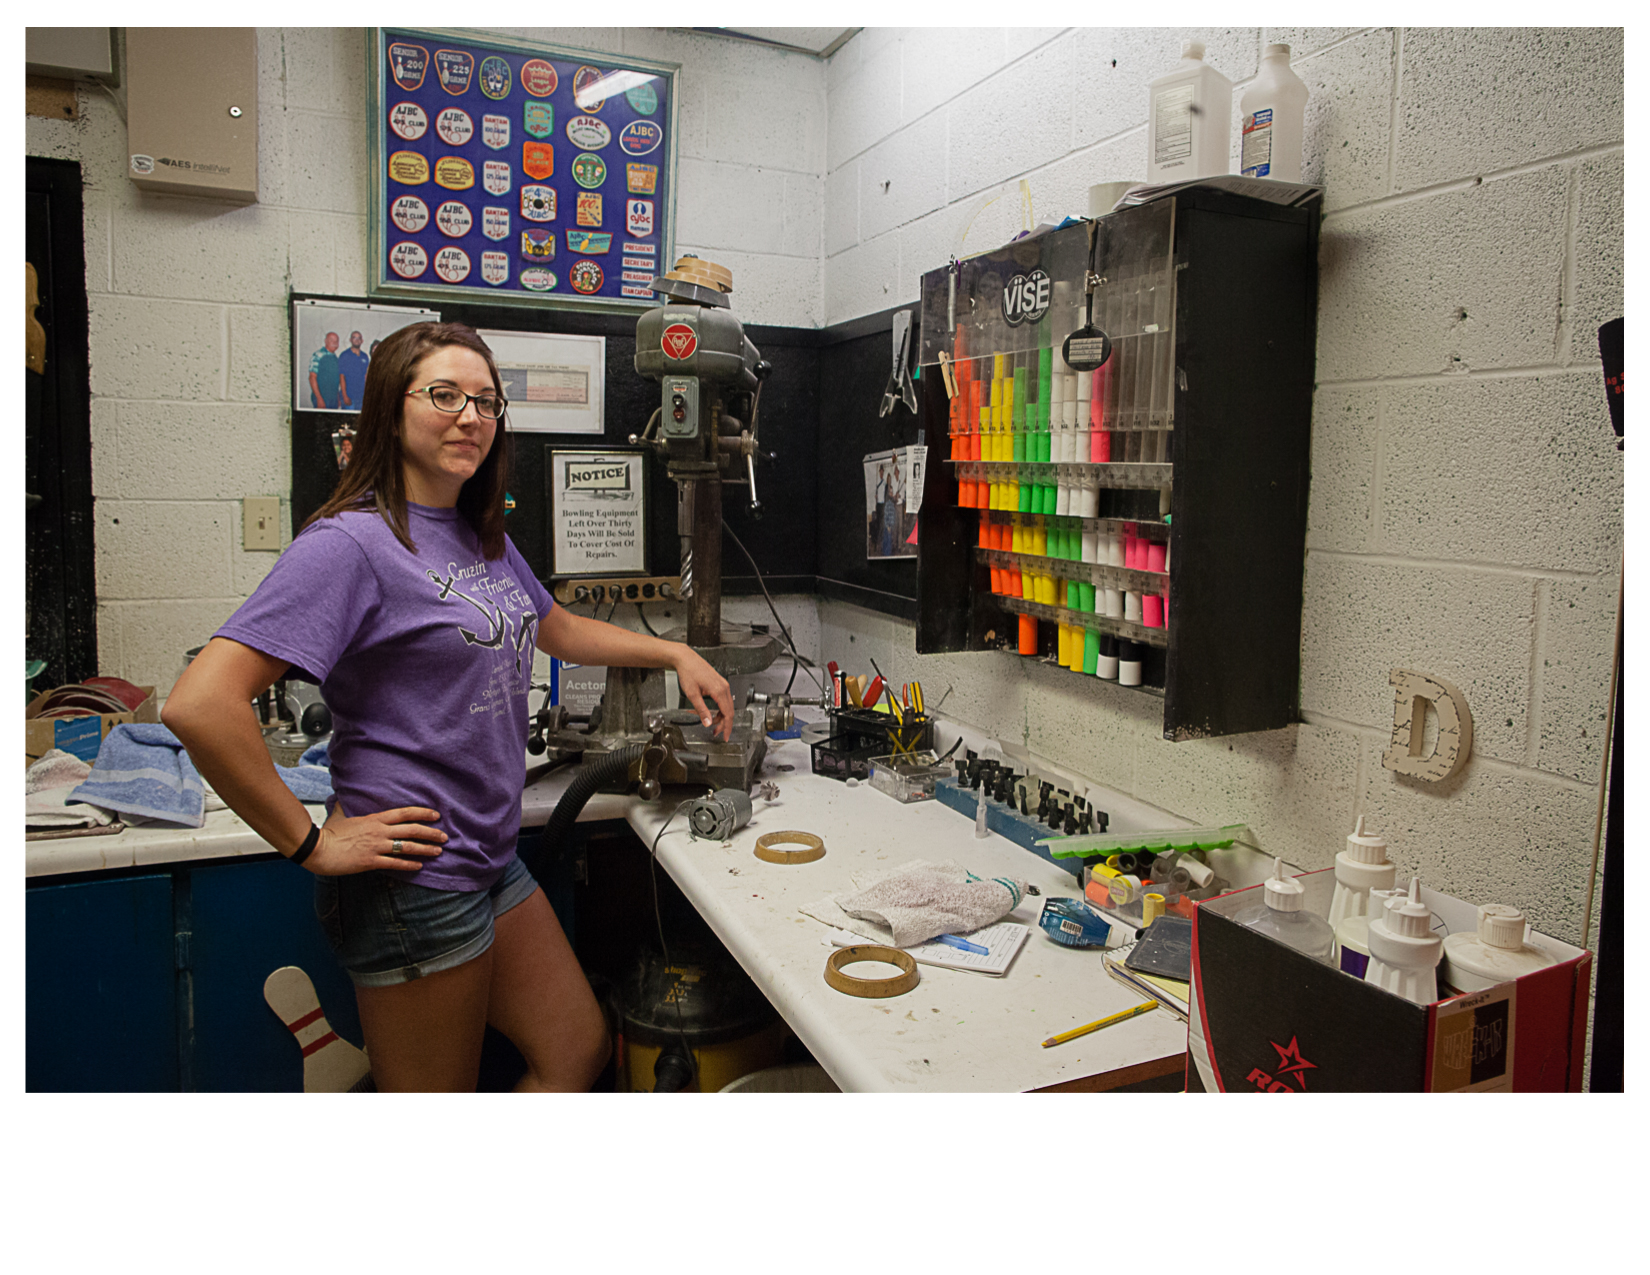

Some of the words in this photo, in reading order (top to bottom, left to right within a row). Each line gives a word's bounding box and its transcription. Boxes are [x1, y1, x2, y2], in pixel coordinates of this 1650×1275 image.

[393, 47, 418, 58] SENIOR
[438, 53, 463, 62] SENIOR
[406, 60, 423, 70] 200
[452, 65, 470, 74] 225
[396, 106, 418, 116] AJBC
[442, 112, 464, 122] AJBC
[484, 116, 508, 124] BANTAM
[578, 118, 601, 129] AJBC
[630, 124, 654, 136] AJBC
[171, 160, 191, 169] AES
[534, 188, 541, 197] 4
[398, 199, 419, 209] AJBC
[442, 205, 463, 214] AJBC
[397, 246, 418, 255] AJBC
[624, 244, 654, 252] PRESIDENT
[440, 251, 462, 260] AJBC
[624, 258, 653, 267] SECRETARY
[624, 273, 652, 281] TREASURER
[623, 287, 634, 295] TEAM
[634, 288, 653, 296] CAPTAIN
[571, 467, 624, 482] NOTICE
[562, 509, 594, 518] Bowling
[596, 509, 638, 518] Equipment
[569, 520, 585, 528] Left
[609, 519, 632, 528] Thirty
[567, 530, 586, 538] Days
[579, 540, 603, 548] Cover
[586, 551, 618, 559] Repairs.
[448, 560, 486, 581] Cruzin
[504, 596, 517, 612] &
[1382, 667, 1466, 783] D
